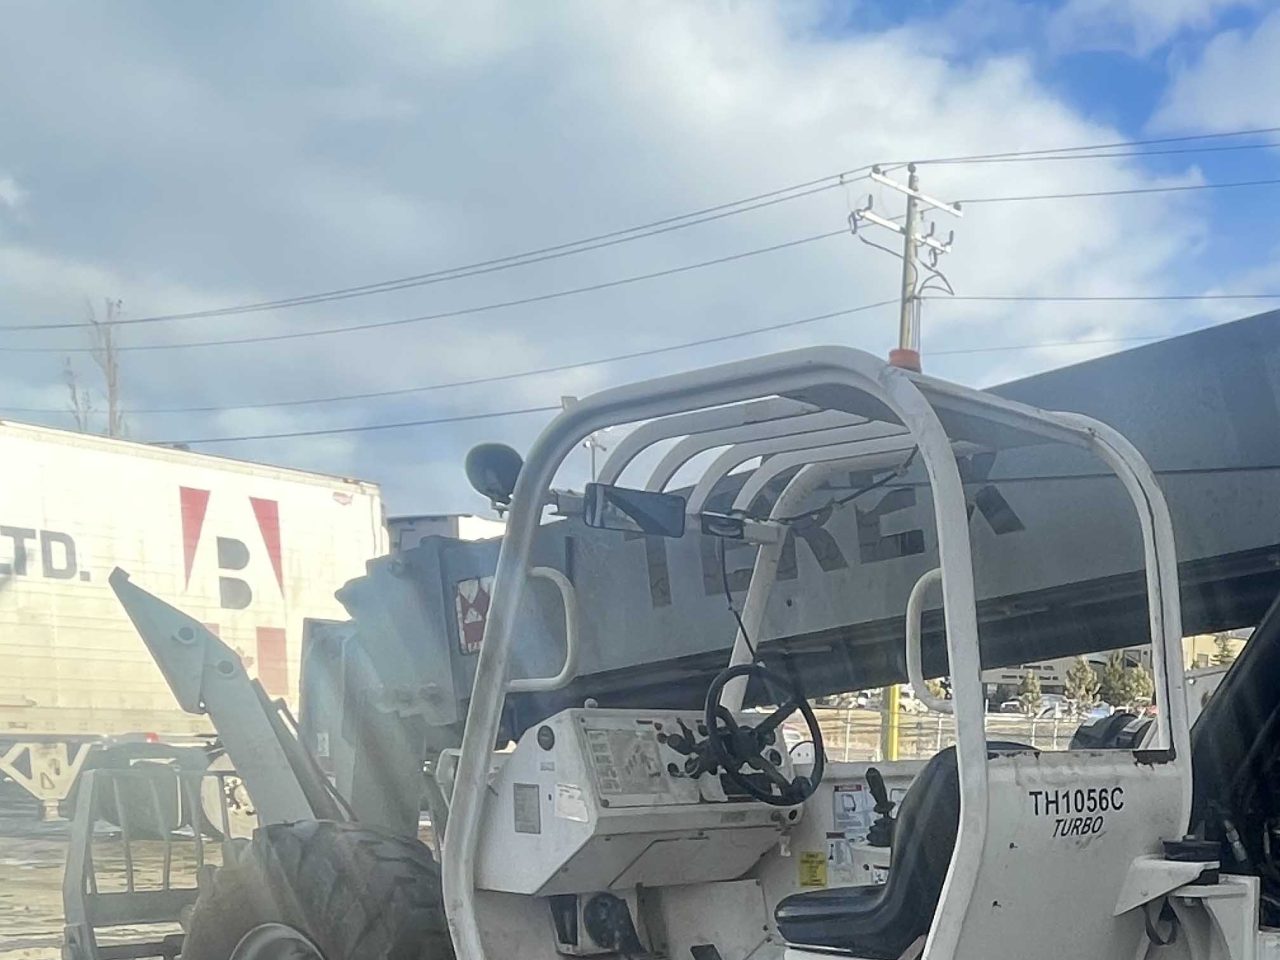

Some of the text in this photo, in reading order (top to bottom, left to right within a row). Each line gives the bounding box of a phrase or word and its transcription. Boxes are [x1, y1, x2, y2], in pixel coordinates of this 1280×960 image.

[0, 524, 91, 582] TD.
[1029, 787, 1124, 816] TH1056C
[1052, 816, 1104, 838] TURBO
